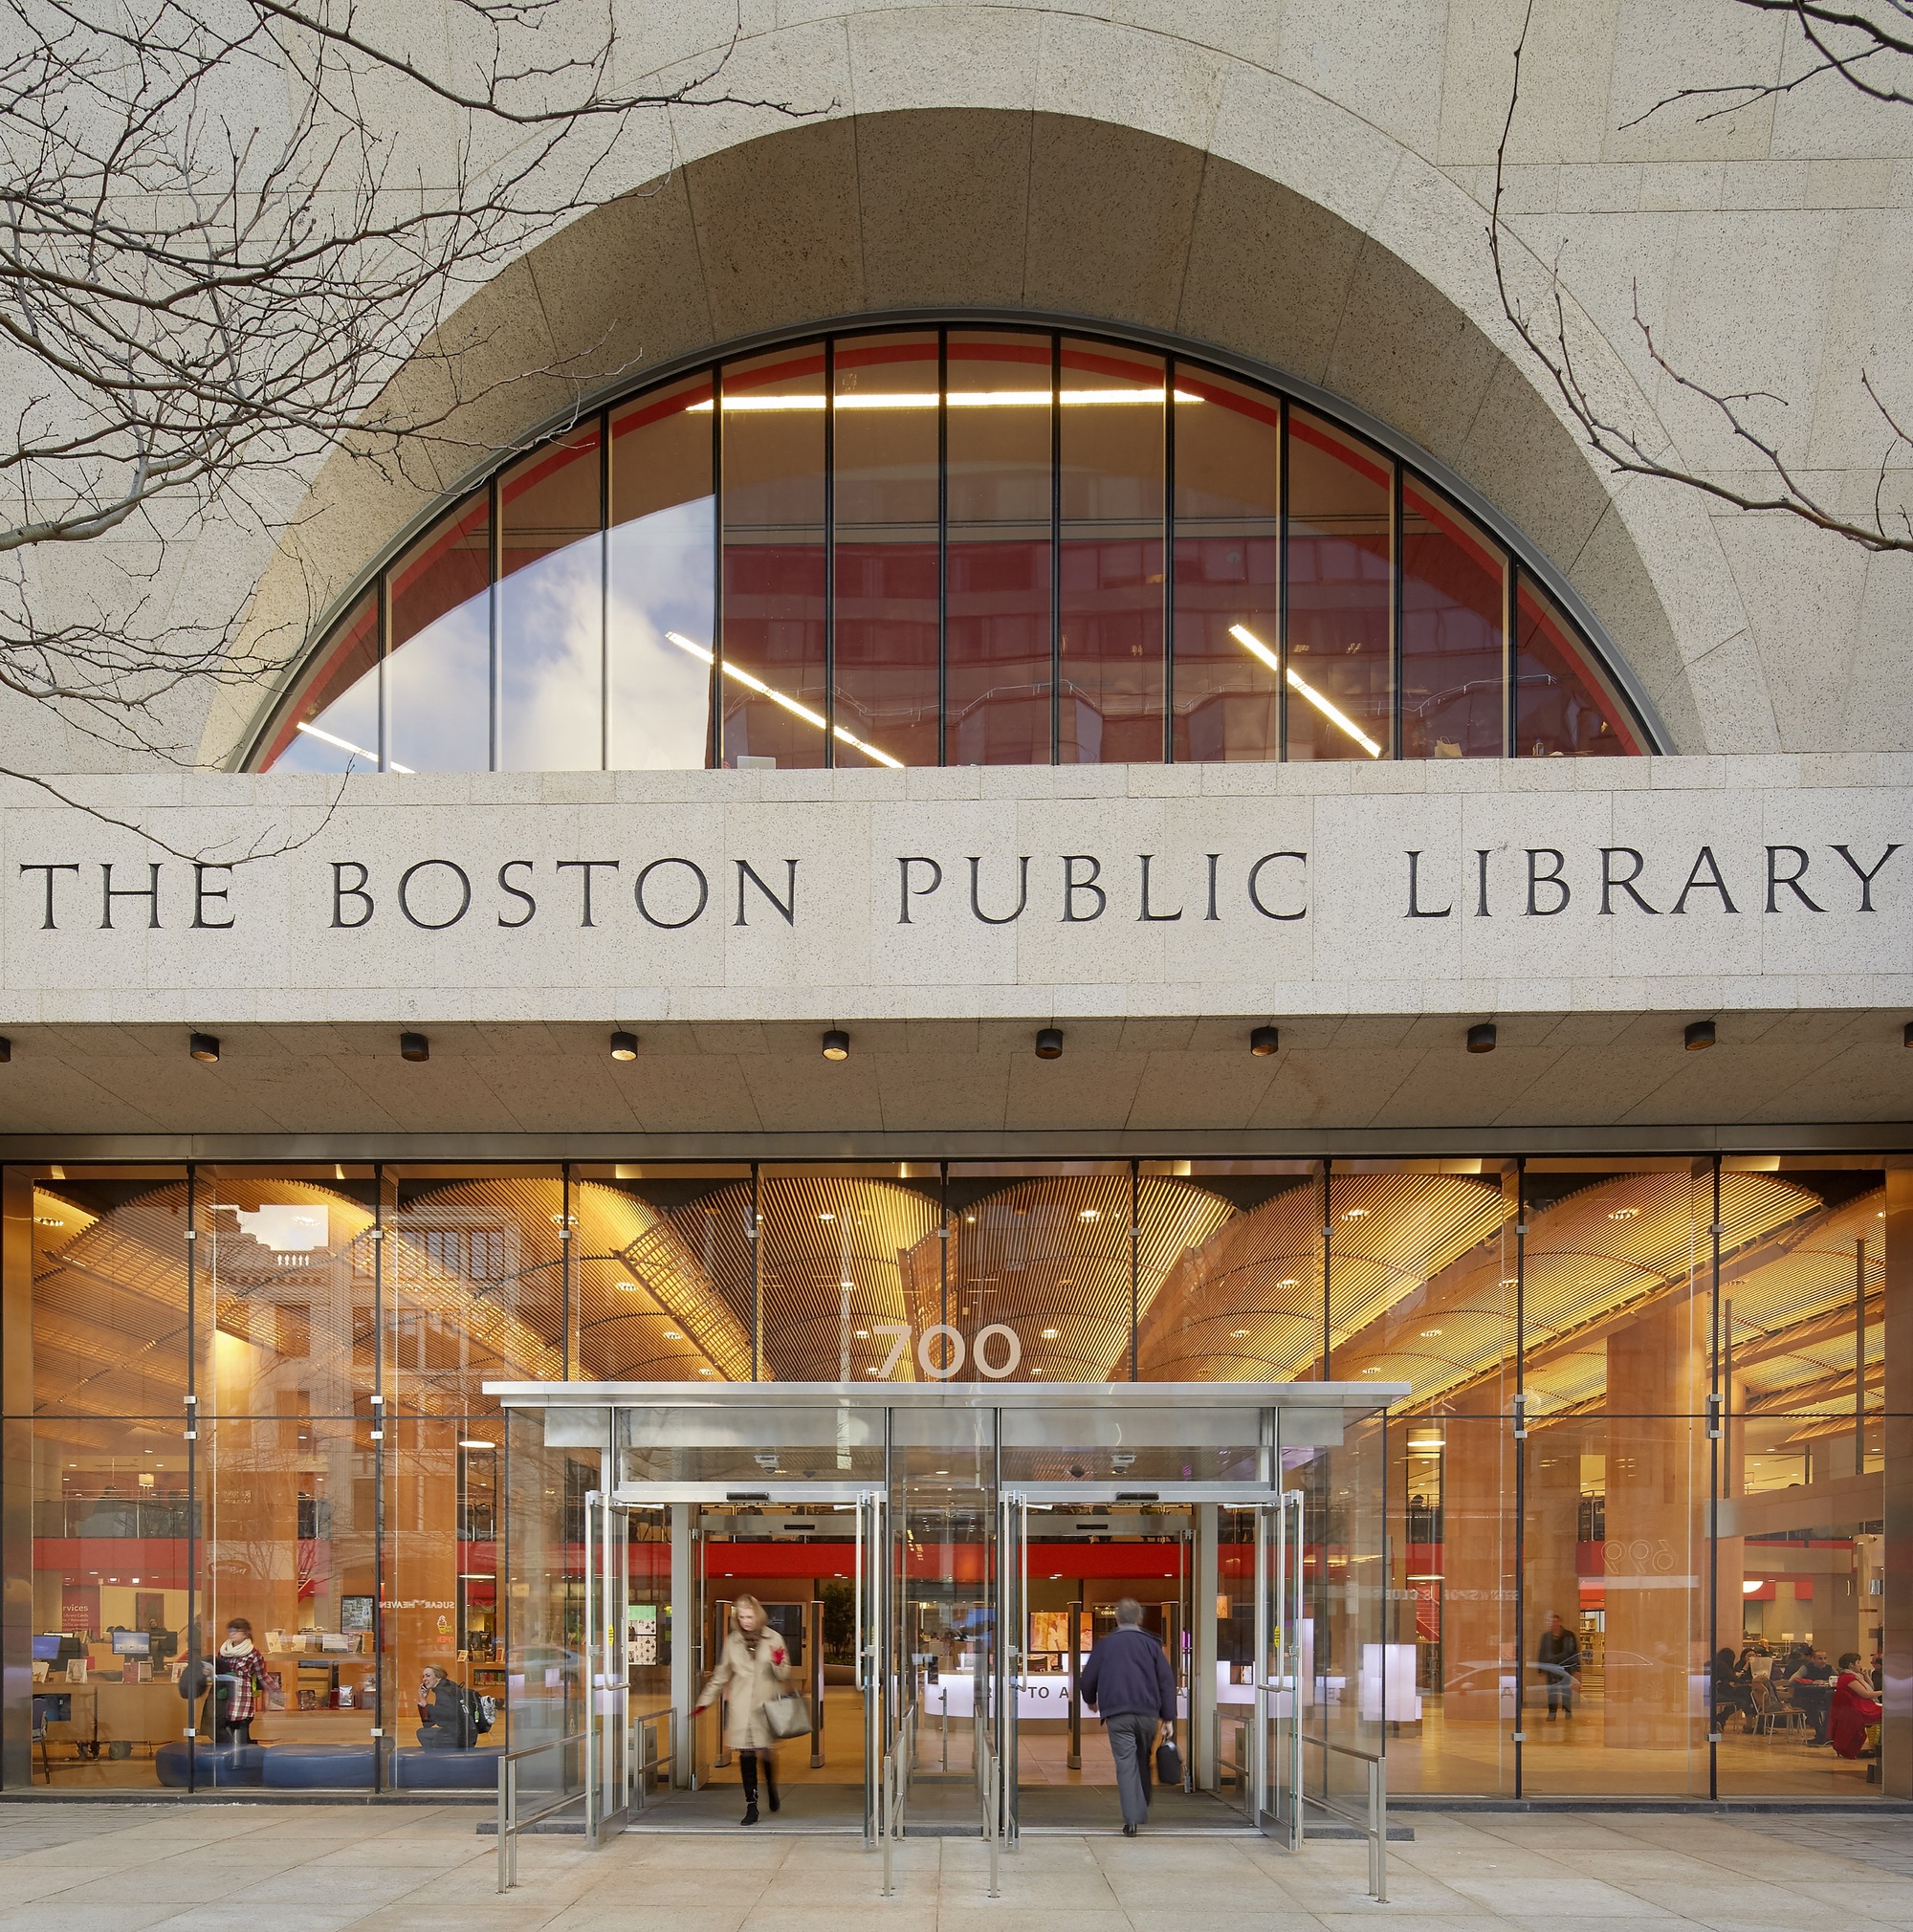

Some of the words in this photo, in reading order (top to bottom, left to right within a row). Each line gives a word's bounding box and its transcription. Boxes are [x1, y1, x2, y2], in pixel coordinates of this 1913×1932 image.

[19, 862, 237, 930] THE
[328, 857, 801, 930] BOSTON
[895, 851, 1308, 925] PUBLIC
[1402, 843, 1903, 919] LIBRARY
[873, 1324, 1021, 1378] 700
[62, 1603, 89, 1612] rvices
[1027, 1686, 1050, 1699] TO
